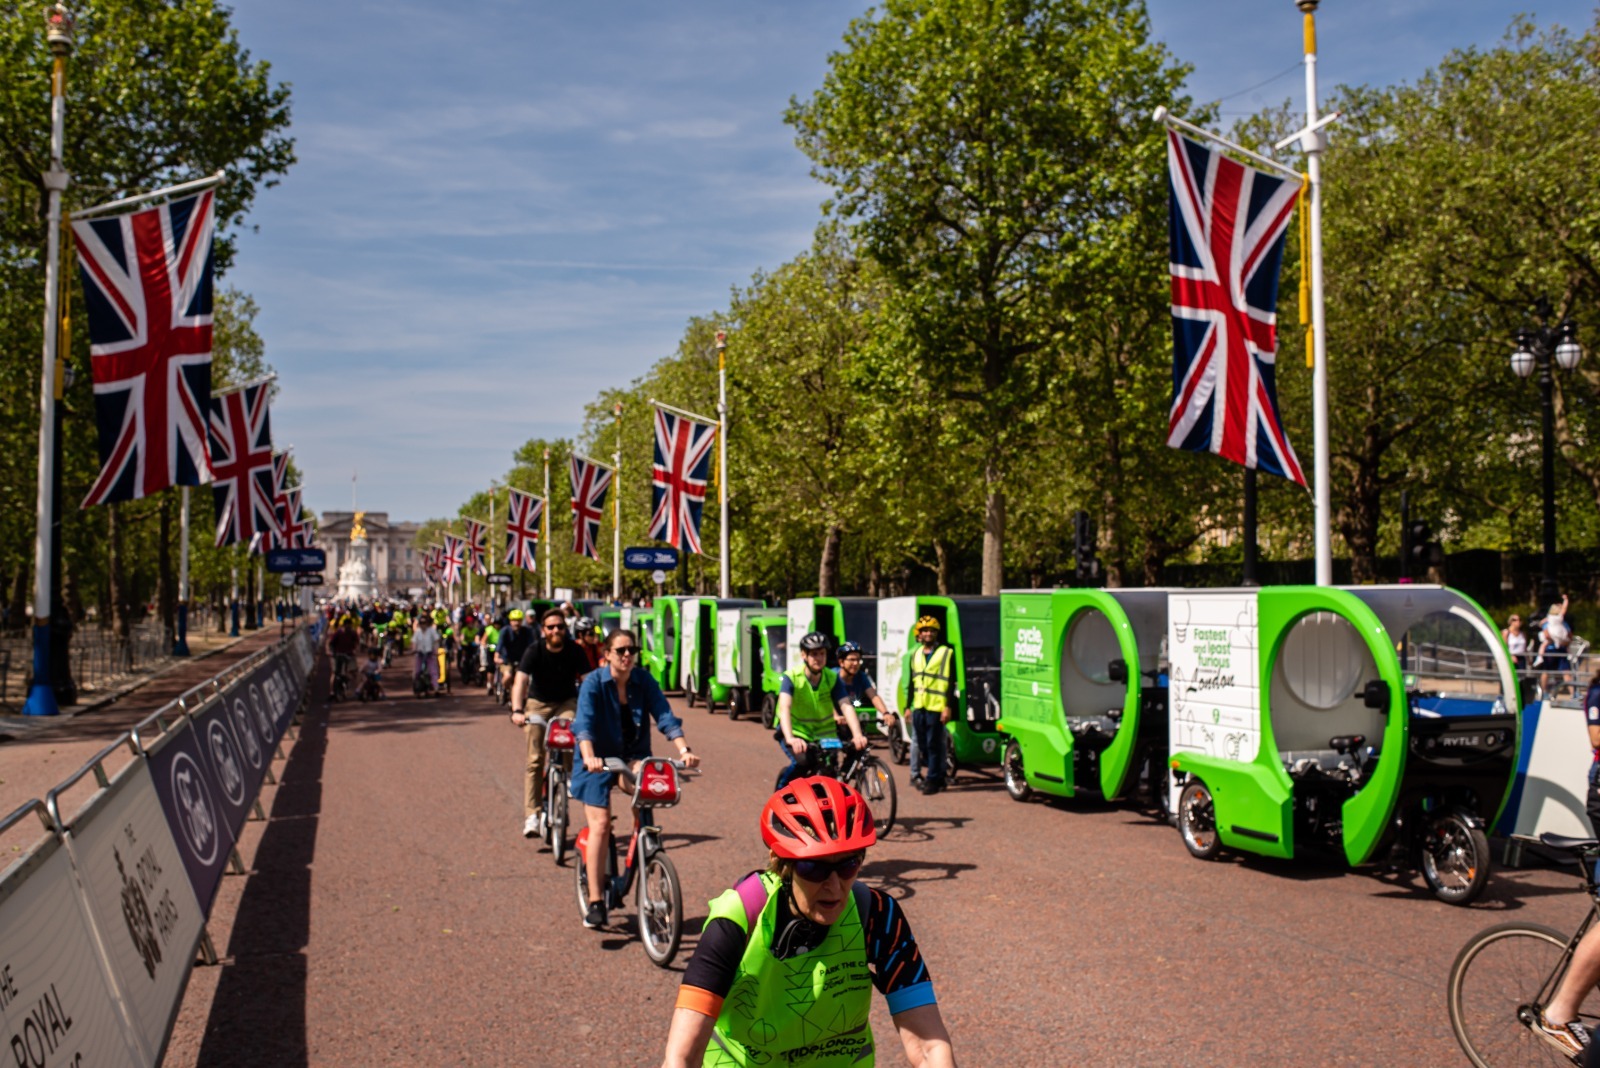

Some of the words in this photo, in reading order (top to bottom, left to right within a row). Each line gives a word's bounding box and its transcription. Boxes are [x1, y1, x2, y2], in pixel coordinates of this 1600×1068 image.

[1194, 628, 1227, 641] Fastest
[1193, 645, 1206, 654] and
[1208, 641, 1231, 655] least
[1198, 653, 1231, 668] furious
[1443, 736, 1480, 746] RYTLE
[820, 964, 841, 978] PARK
[841, 960, 857, 970] THE
[0, 963, 19, 1012] HE
[10, 982, 73, 1068] ROYAL
